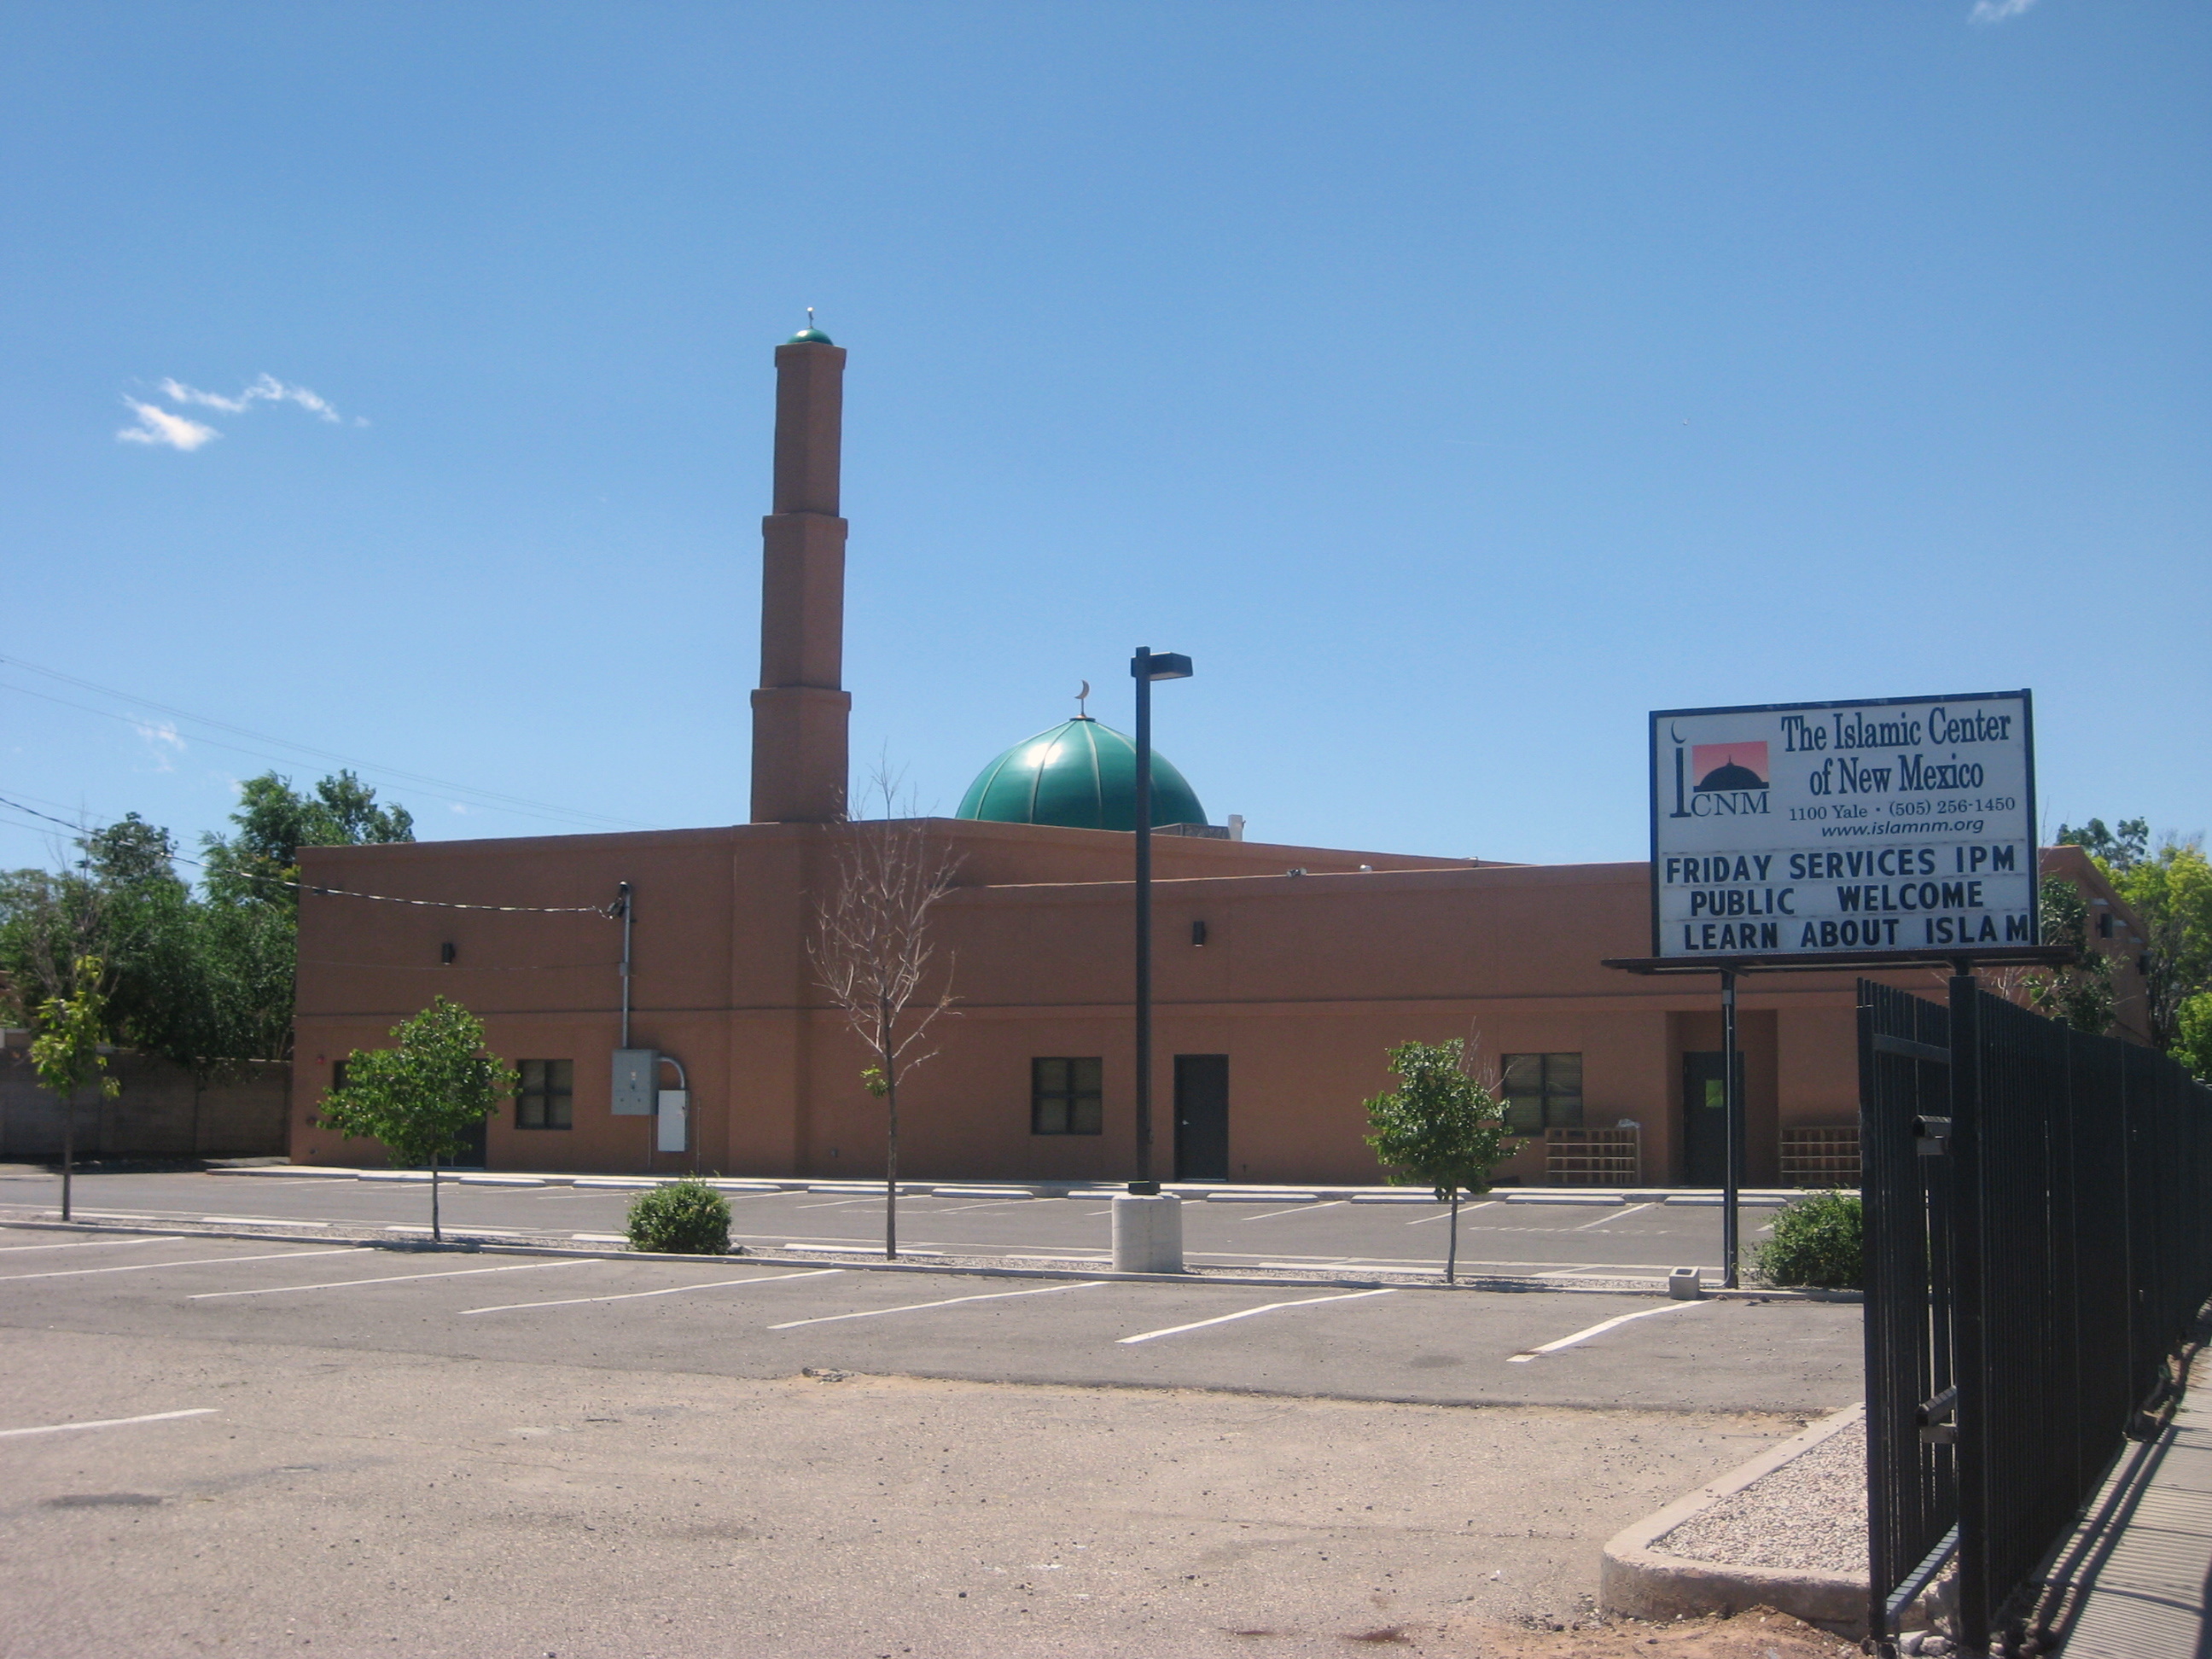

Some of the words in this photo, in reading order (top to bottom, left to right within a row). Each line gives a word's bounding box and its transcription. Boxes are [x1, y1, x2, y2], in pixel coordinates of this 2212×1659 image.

[1781, 715, 1826, 752] The
[1833, 712, 1921, 749] Islamic
[1929, 707, 2011, 744] Center
[1810, 760, 1833, 795] of
[1838, 757, 1891, 794] New
[1898, 754, 1983, 791] Mexico
[1790, 806, 1826, 821] 1100
[1832, 804, 1867, 820] Yale
[1889, 800, 1930, 818] (505)
[1937, 797, 2015, 814] 256-1450
[1822, 818, 1983, 837] www.islamnm.org
[1668, 855, 1772, 883] FRIDAY
[1790, 848, 1936, 879] SERVICES
[1691, 888, 1795, 917] PUBLIC
[1837, 881, 1983, 912] WELCOME
[1685, 922, 1778, 951] LEARN
[1801, 918, 1900, 947] ABOUT
[1926, 914, 2029, 944] ISLAM
